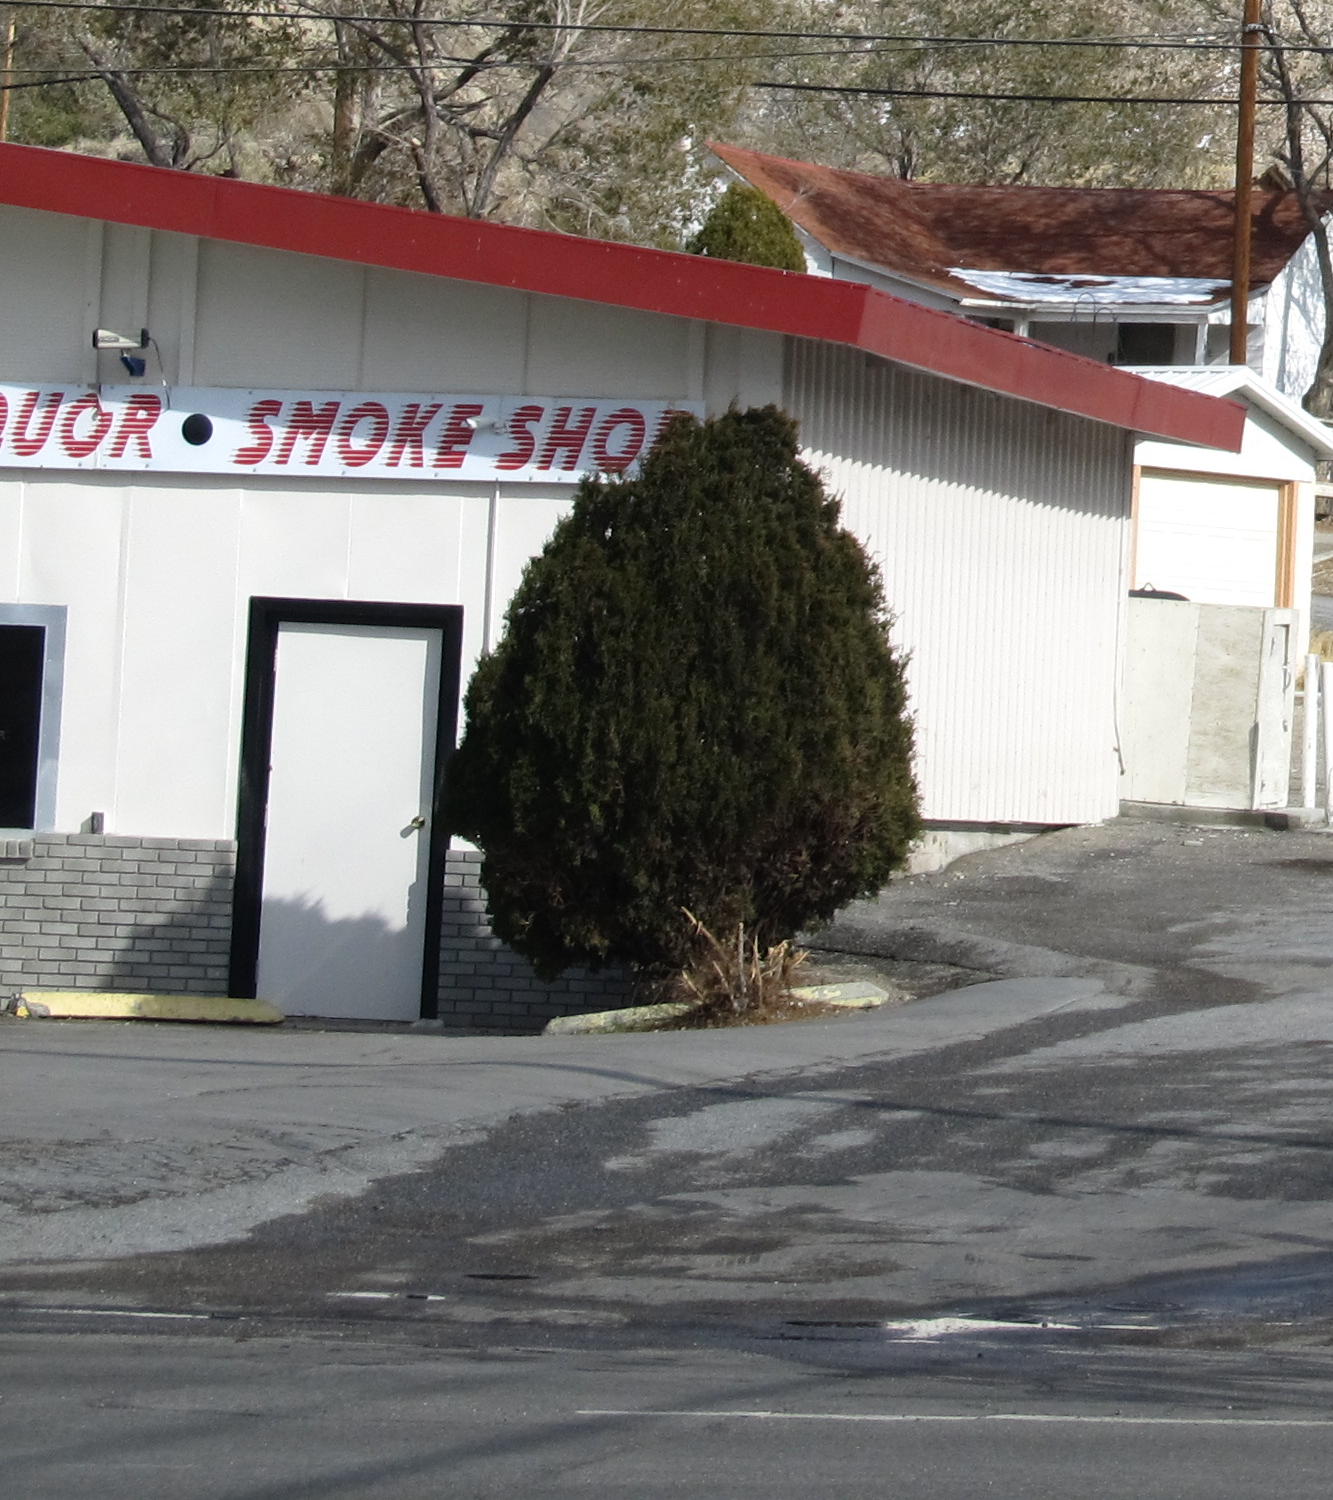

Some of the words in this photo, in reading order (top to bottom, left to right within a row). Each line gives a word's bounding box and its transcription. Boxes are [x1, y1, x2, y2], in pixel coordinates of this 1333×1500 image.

[0, 391, 153, 459] UOR
[229, 399, 484, 469] SMOKE
[490, 404, 693, 473] SHO
